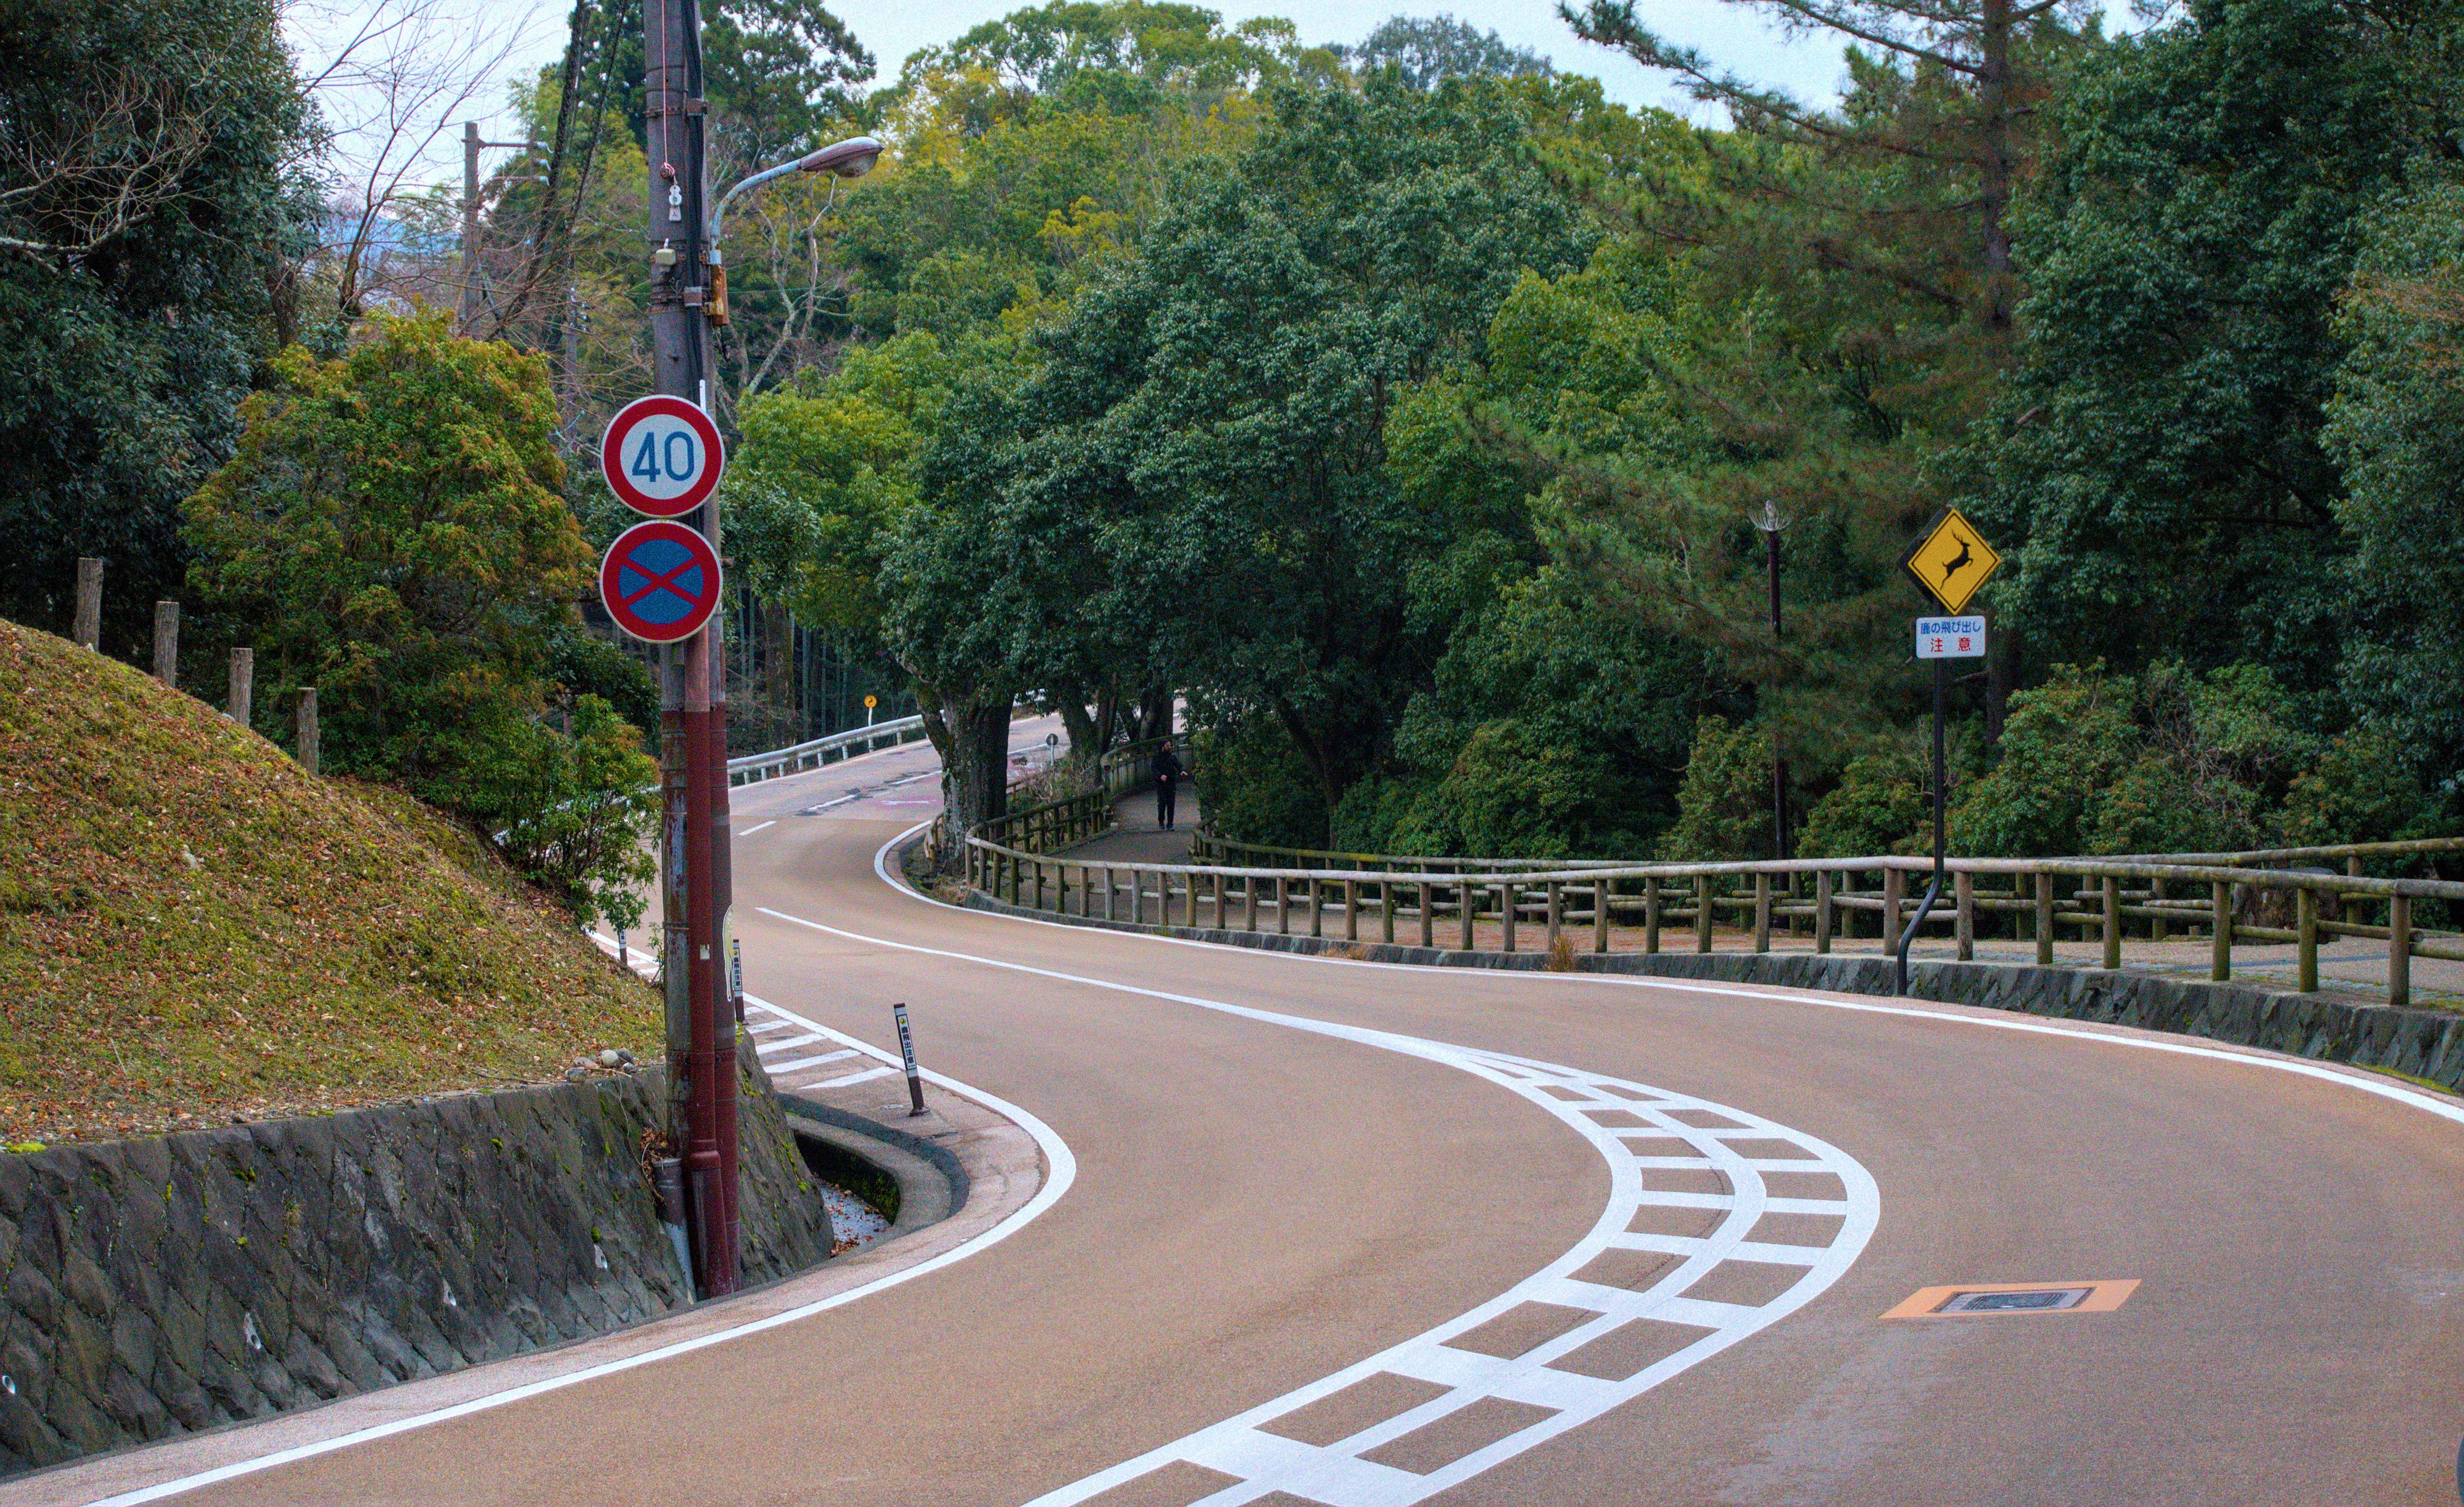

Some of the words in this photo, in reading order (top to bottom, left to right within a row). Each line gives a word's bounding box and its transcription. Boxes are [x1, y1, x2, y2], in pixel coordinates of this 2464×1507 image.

[632, 431, 694, 482] 40
[1920, 621, 1981, 634] 鹿の飛び出し
[901, 1026, 915, 1064] 鹿飛出注意
